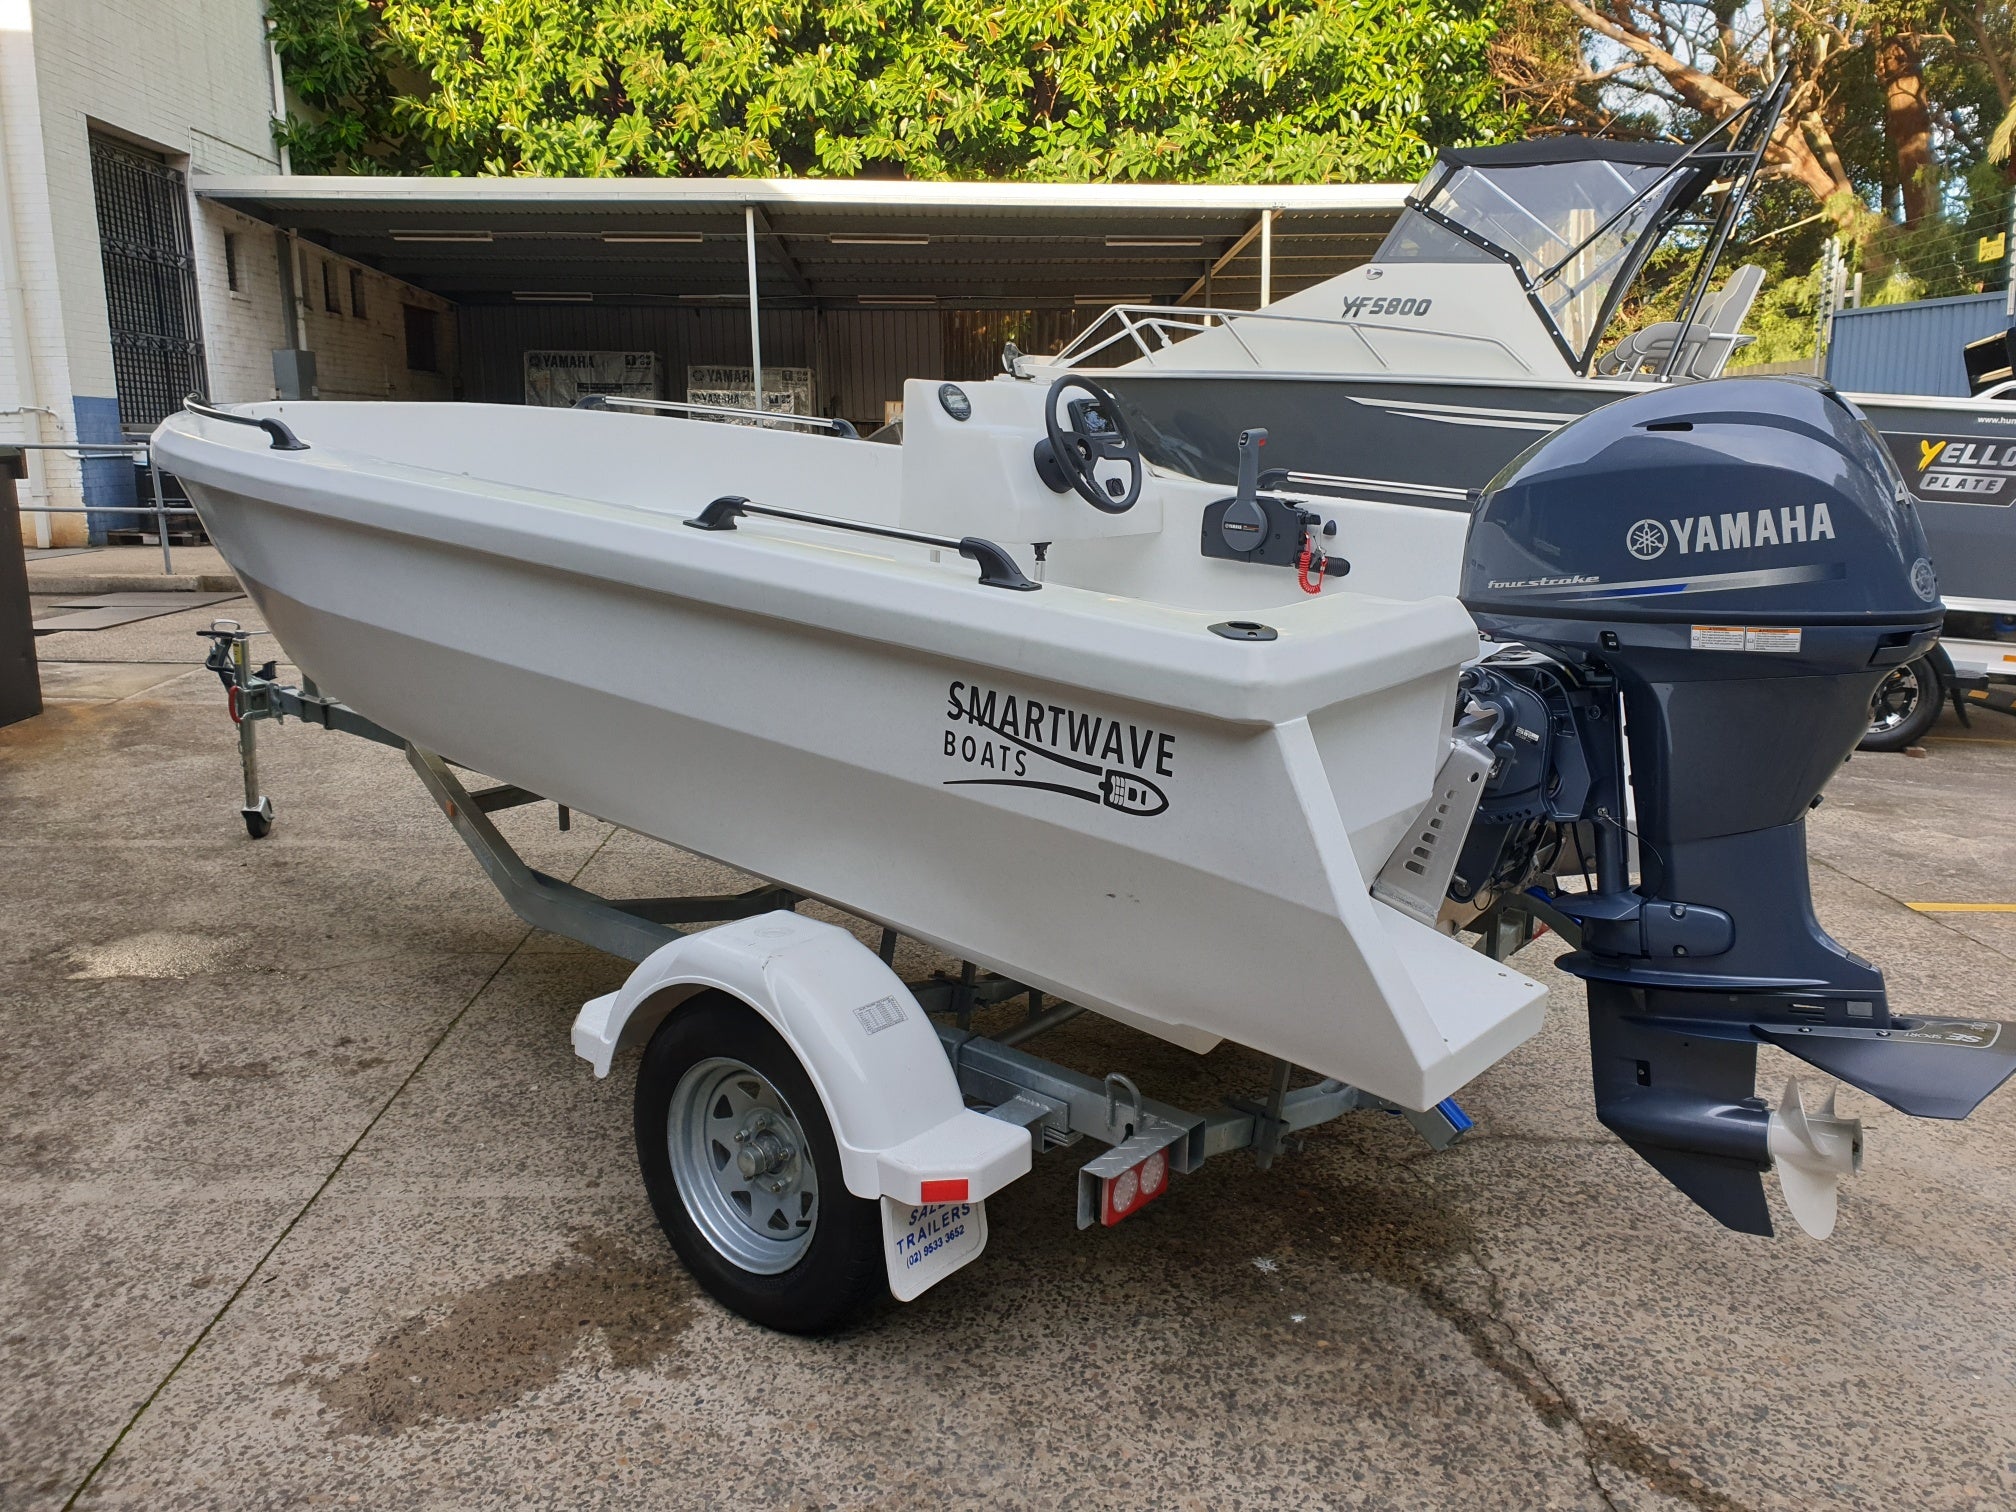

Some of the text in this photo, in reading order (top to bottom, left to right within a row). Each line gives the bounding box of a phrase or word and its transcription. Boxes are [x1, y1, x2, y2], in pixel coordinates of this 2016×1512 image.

[1341, 296, 1432, 319] YF5800
[542, 355, 595, 368] YAMAHA
[1925, 476, 1999, 491] PLATE
[1669, 502, 1836, 555] YAMAHA
[946, 680, 1176, 778] SMARTWAVE
[943, 730, 1027, 777] BOATS
[896, 1203, 971, 1255] TRAILERS
[906, 1224, 965, 1270] (02) 9533 3652
